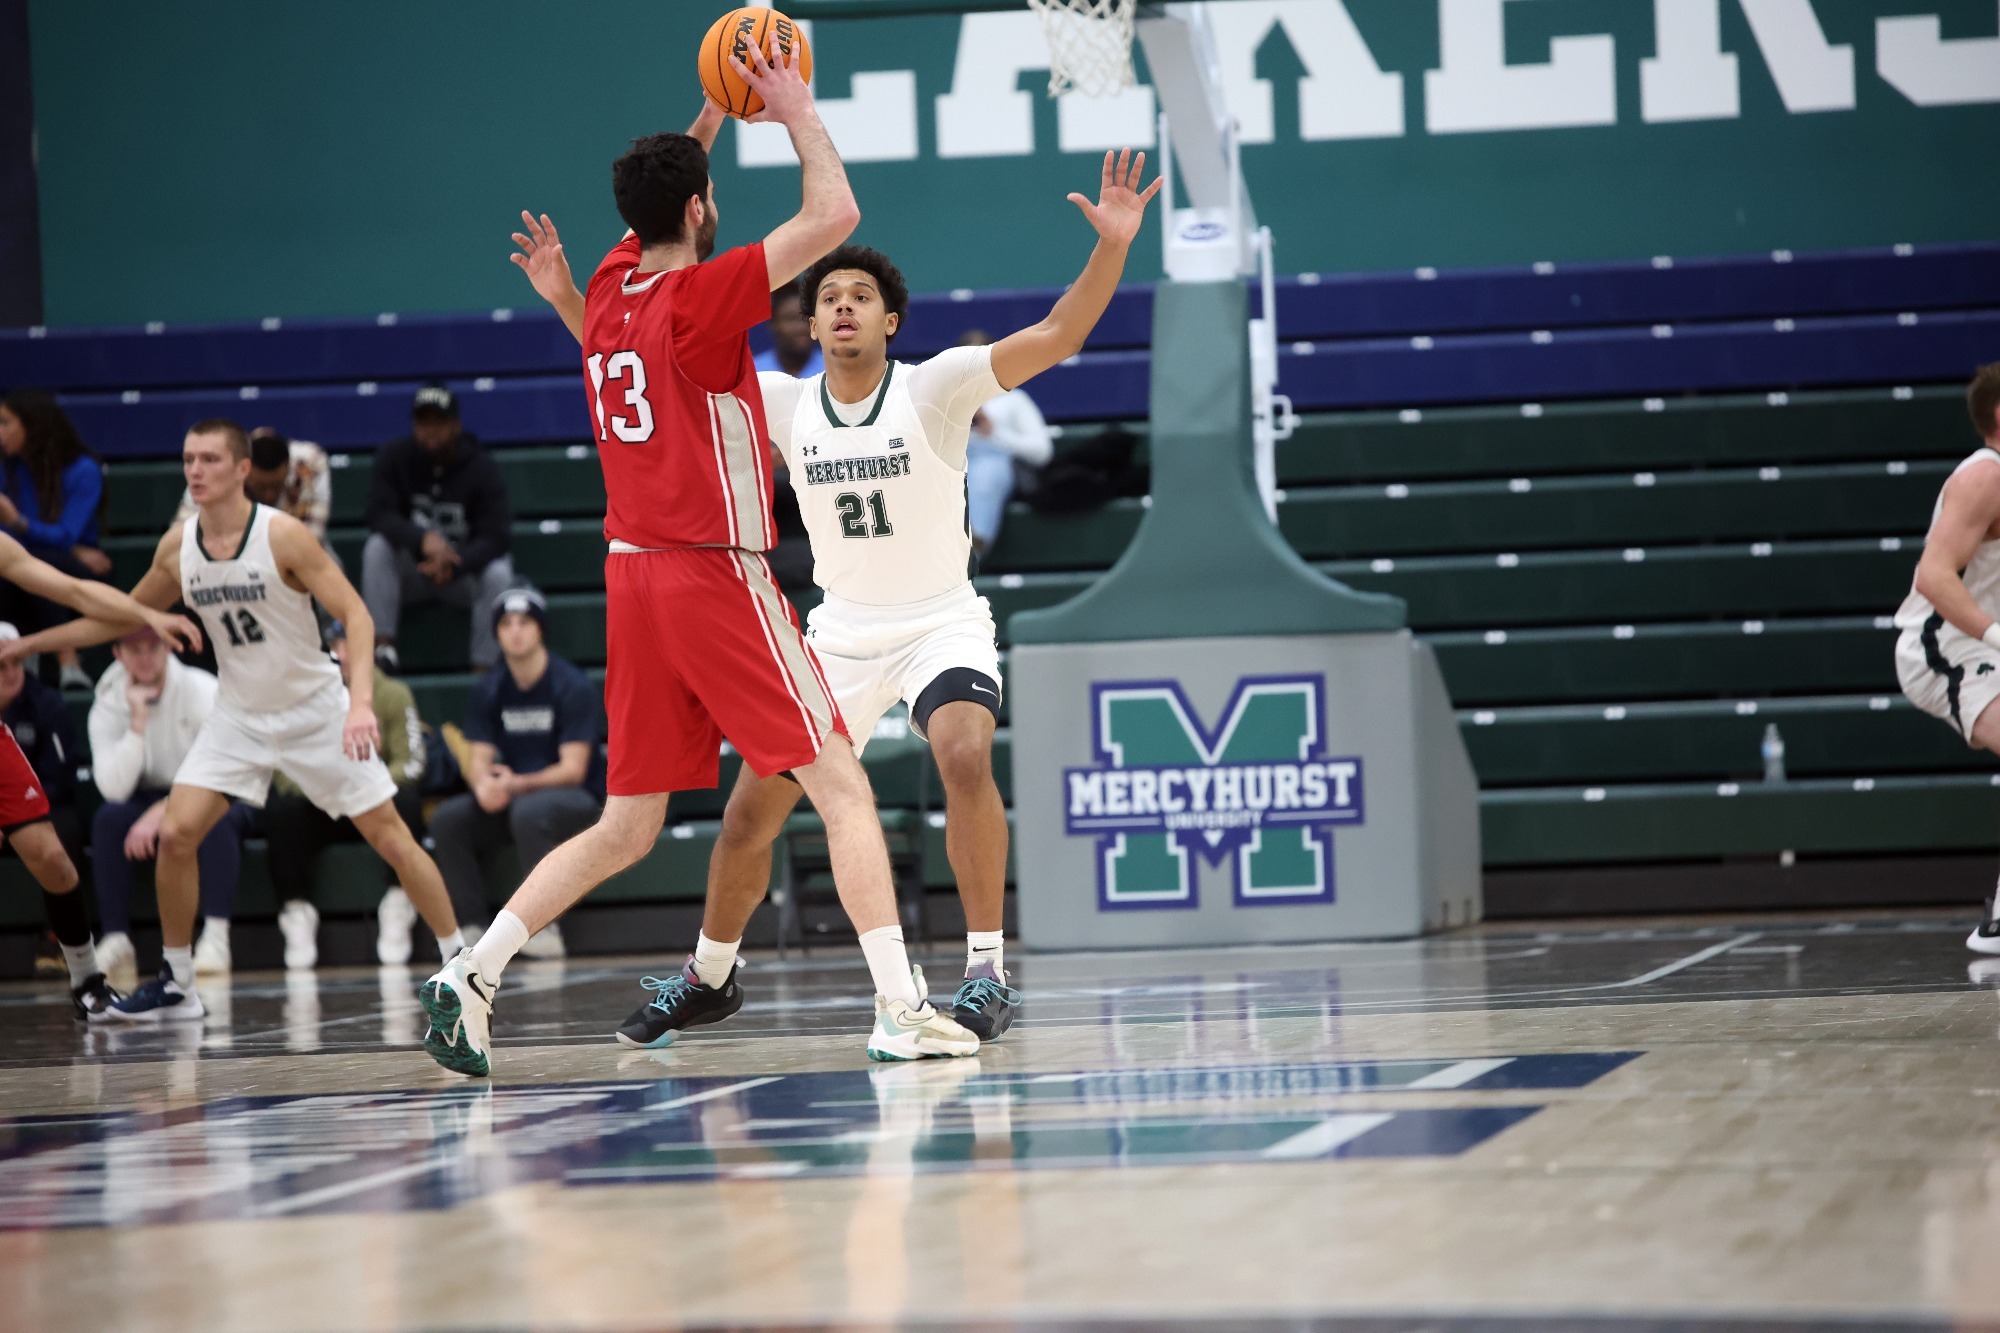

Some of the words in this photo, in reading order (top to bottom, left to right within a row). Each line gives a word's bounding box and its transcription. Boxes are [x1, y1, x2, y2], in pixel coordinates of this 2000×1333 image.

[587, 349, 655, 443] 13
[805, 453, 911, 485] MERCYHURST
[835, 490, 893, 538] 21
[221, 609, 265, 645] 12
[1069, 761, 1357, 816] MERCYHURST
[1164, 811, 1264, 830] UNIVERSITY
